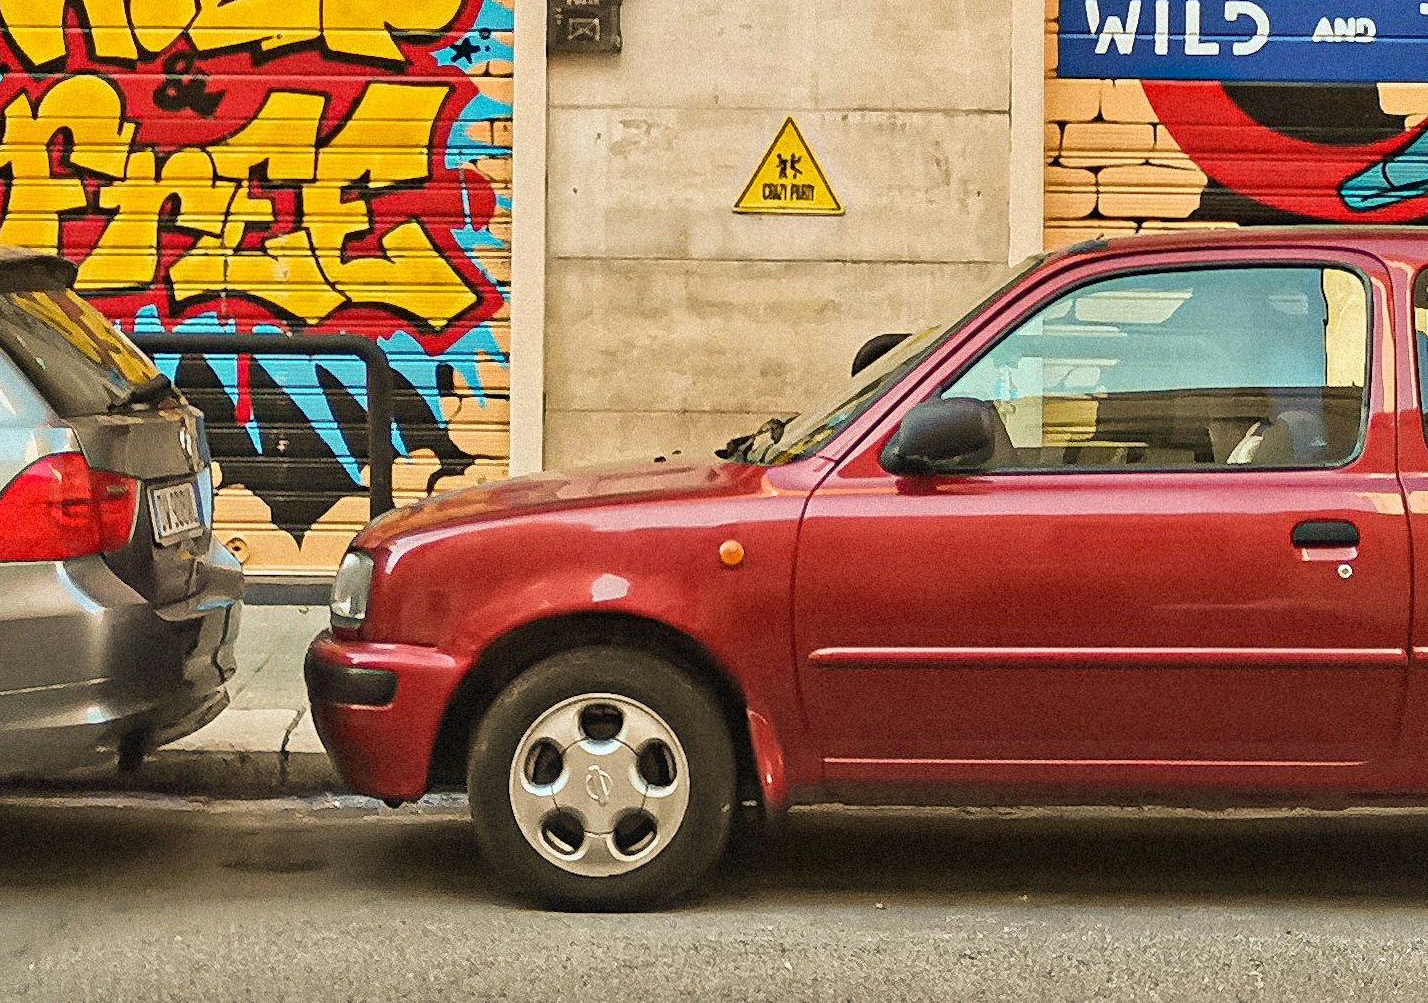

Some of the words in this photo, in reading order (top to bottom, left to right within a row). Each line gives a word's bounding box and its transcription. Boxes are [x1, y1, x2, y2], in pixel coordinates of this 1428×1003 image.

[1310, 16, 1378, 43] AND
[762, 182, 787, 201] CRAZY
[790, 182, 816, 202] PARTY
